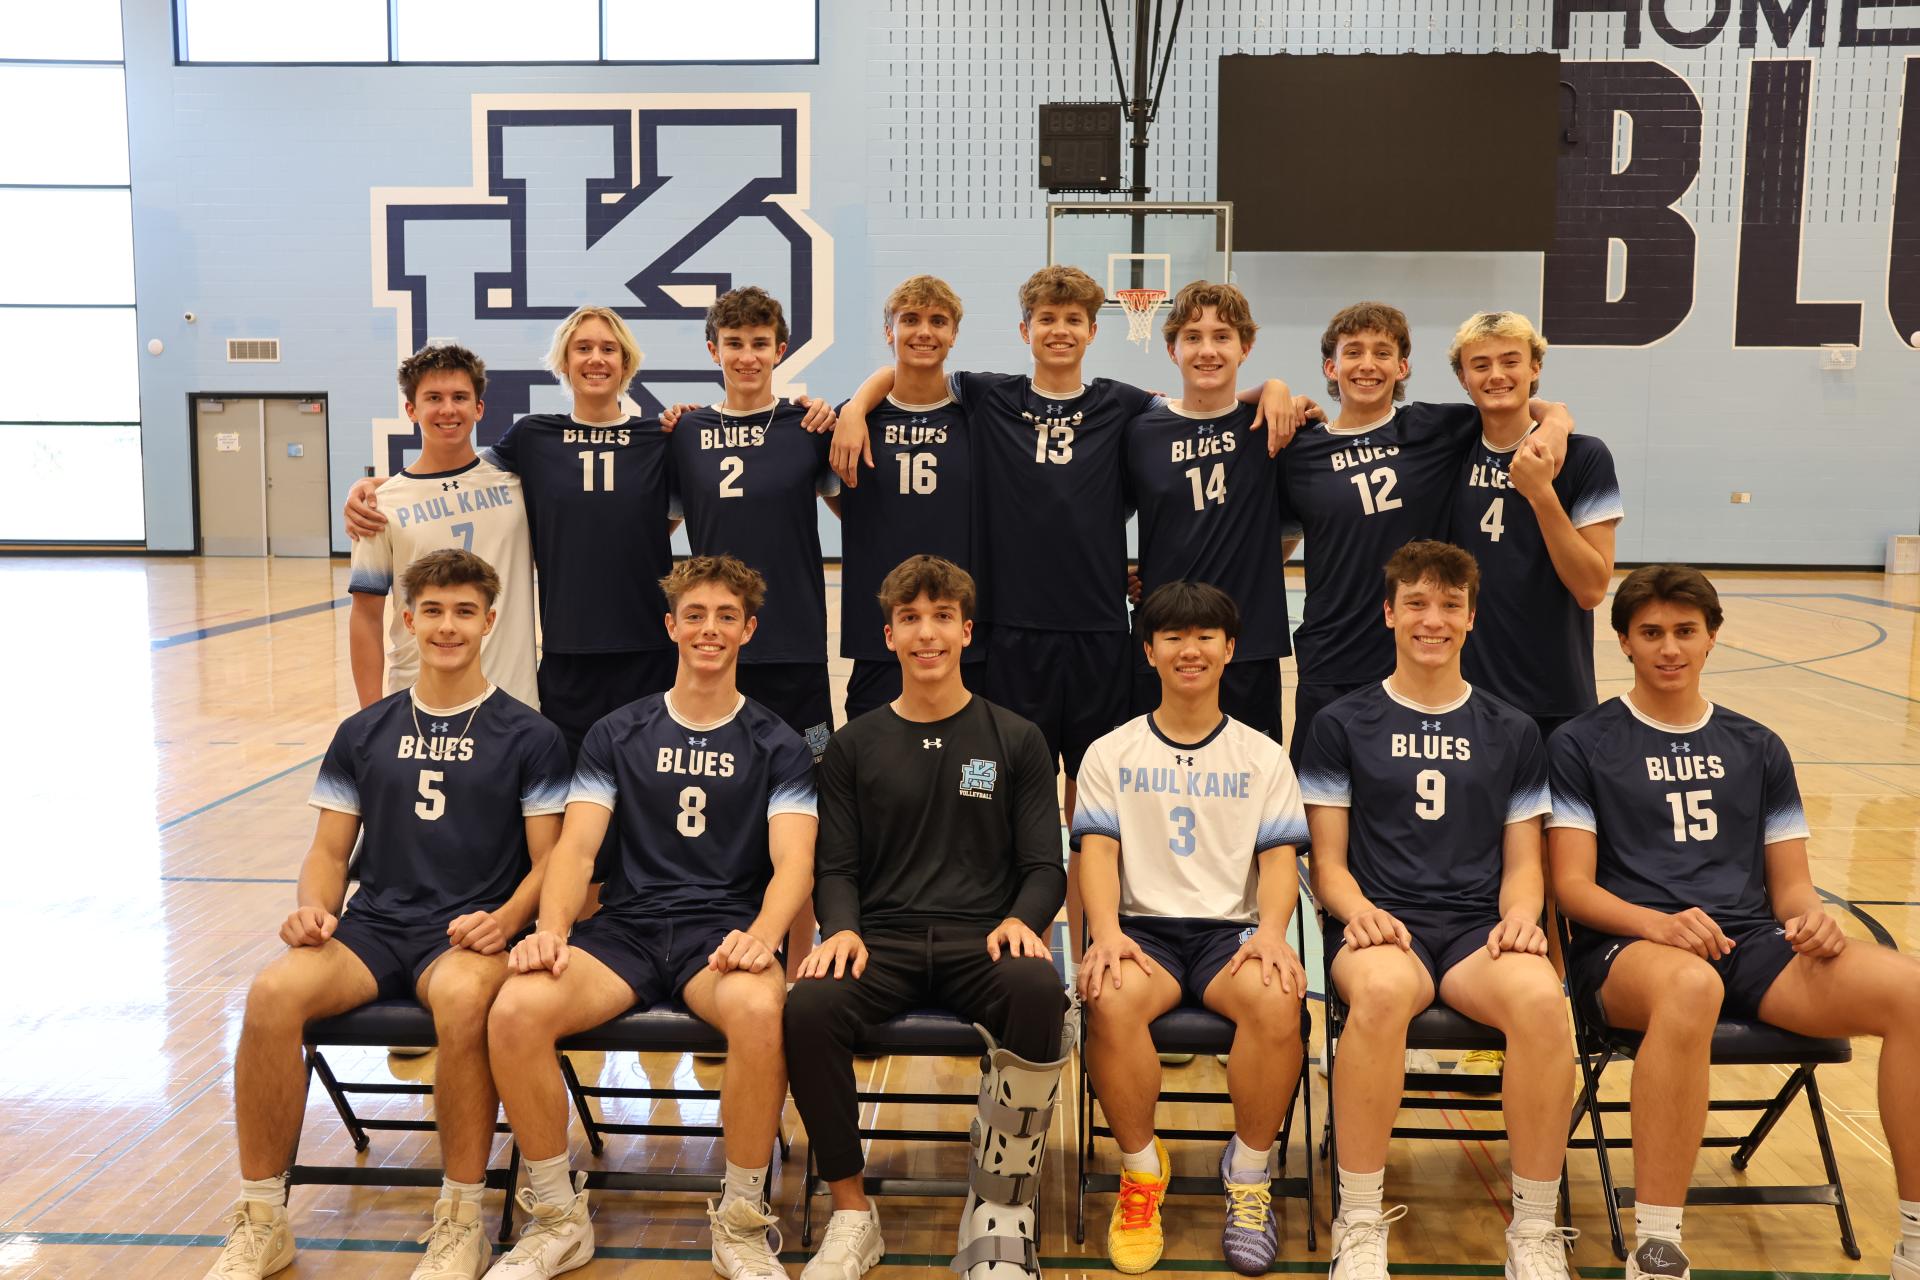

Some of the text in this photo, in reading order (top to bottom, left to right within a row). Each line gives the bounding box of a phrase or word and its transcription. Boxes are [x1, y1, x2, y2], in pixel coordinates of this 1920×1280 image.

[1541, 57, 1920, 350] BL
[563, 429, 631, 446] BLUES
[701, 425, 765, 450] BLUES
[884, 424, 948, 446] BLUES
[1034, 423, 1074, 465] 13
[1171, 430, 1236, 463] BLUES
[578, 450, 615, 492] 11
[718, 455, 744, 499] 2
[895, 452, 937, 495] 16
[1330, 445, 1400, 473] BLUES
[396, 485, 512, 528] PAUL KANE
[1185, 462, 1227, 511] 14
[1350, 466, 1403, 516] 12
[450, 521, 474, 556] 7
[1480, 497, 1505, 542] 4
[397, 735, 474, 762] BLUES
[656, 746, 735, 778] BLUES
[1391, 733, 1471, 761] BLUES
[1645, 754, 1726, 782] BLUES
[414, 769, 446, 821] 5
[959, 789, 993, 800] VOLLEYBALL
[1119, 767, 1251, 799] PAUL KANE
[1415, 769, 1446, 821] 9
[676, 785, 707, 838] 8
[1168, 806, 1197, 858] 3
[1665, 789, 1719, 842] 15
